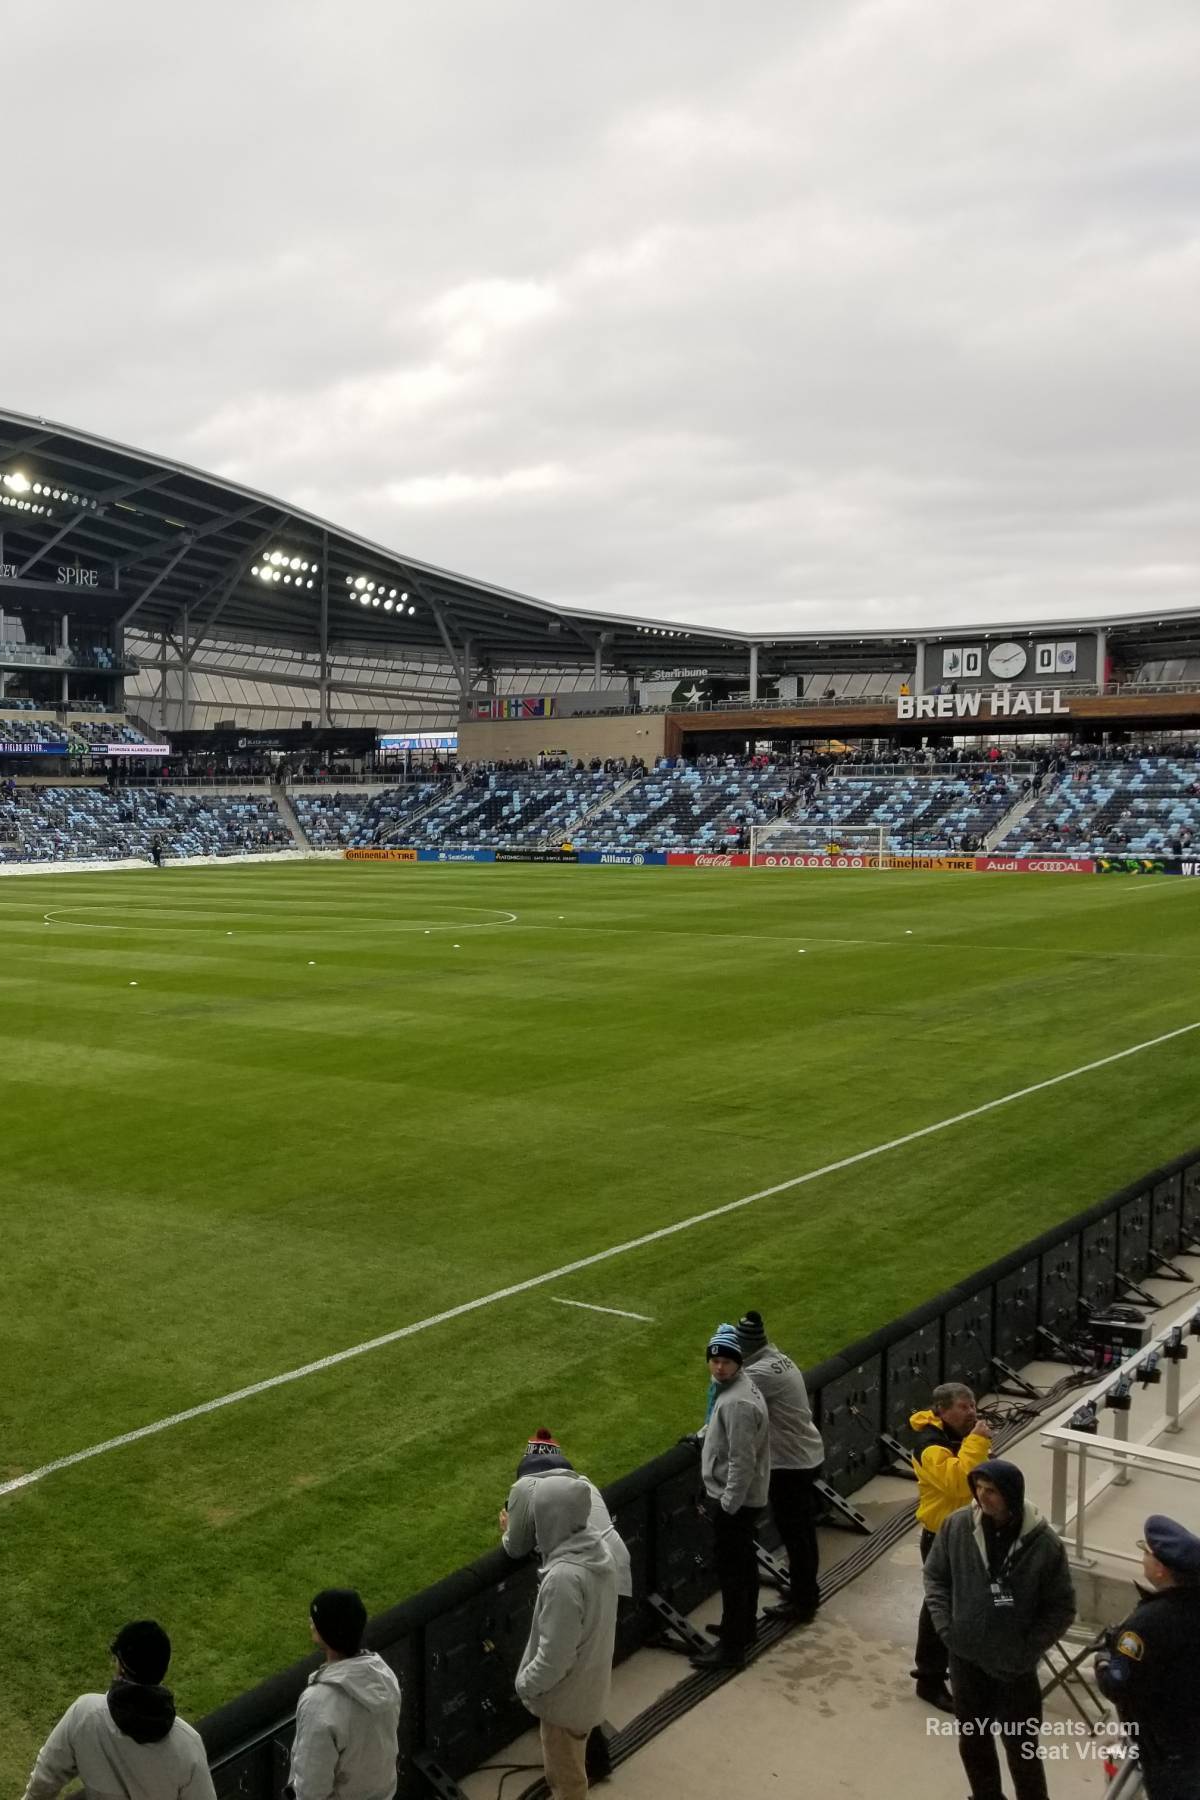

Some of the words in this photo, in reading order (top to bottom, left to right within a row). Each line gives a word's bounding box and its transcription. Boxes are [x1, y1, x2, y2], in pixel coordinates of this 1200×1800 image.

[56, 567, 99, 586] SPIRE
[897, 692, 981, 719] BREW
[990, 689, 1070, 716] HALL
[346, 850, 389, 860] Continental
[601, 855, 631, 864] Allianz
[869, 857, 933, 869] Continental
[947, 861, 973, 870] TIRE
[987, 861, 1018, 871] Audi
